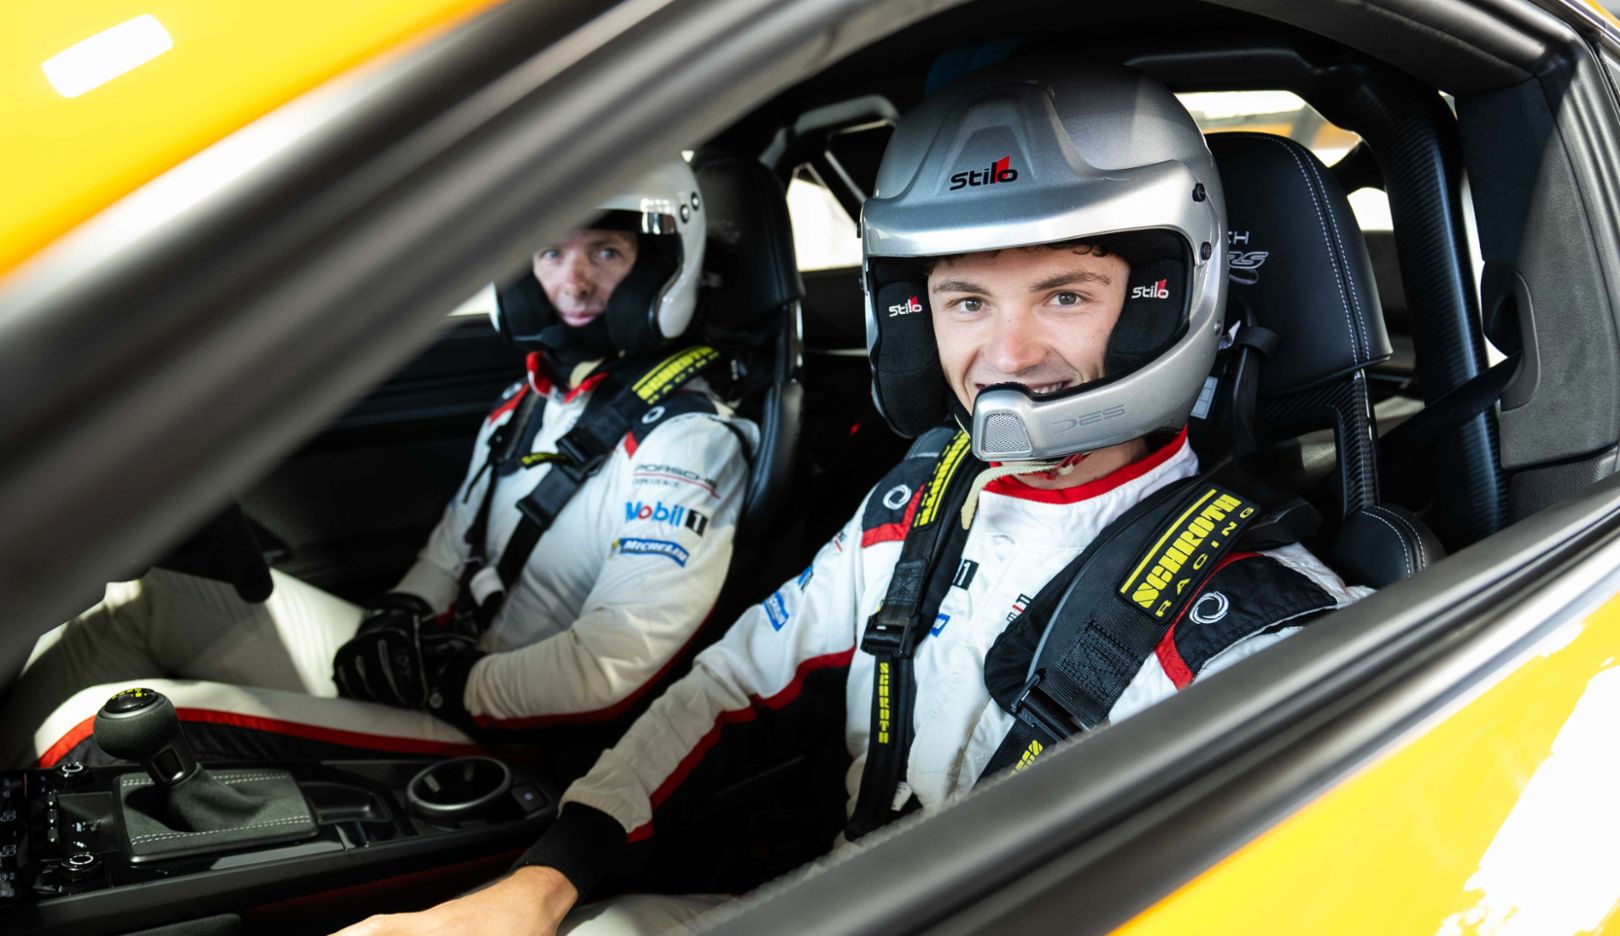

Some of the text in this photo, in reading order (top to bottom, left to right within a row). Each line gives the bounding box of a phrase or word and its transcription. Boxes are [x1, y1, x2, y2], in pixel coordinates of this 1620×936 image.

[949, 156, 1019, 191] Stilo
[888, 296, 923, 317] Stilo
[1131, 279, 1169, 300] Stilo
[625, 501, 685, 527] Mobil
[1132, 494, 1242, 608] SCHROTH
[1156, 506, 1255, 618] RACING
[878, 662, 890, 744] SCHROTH
